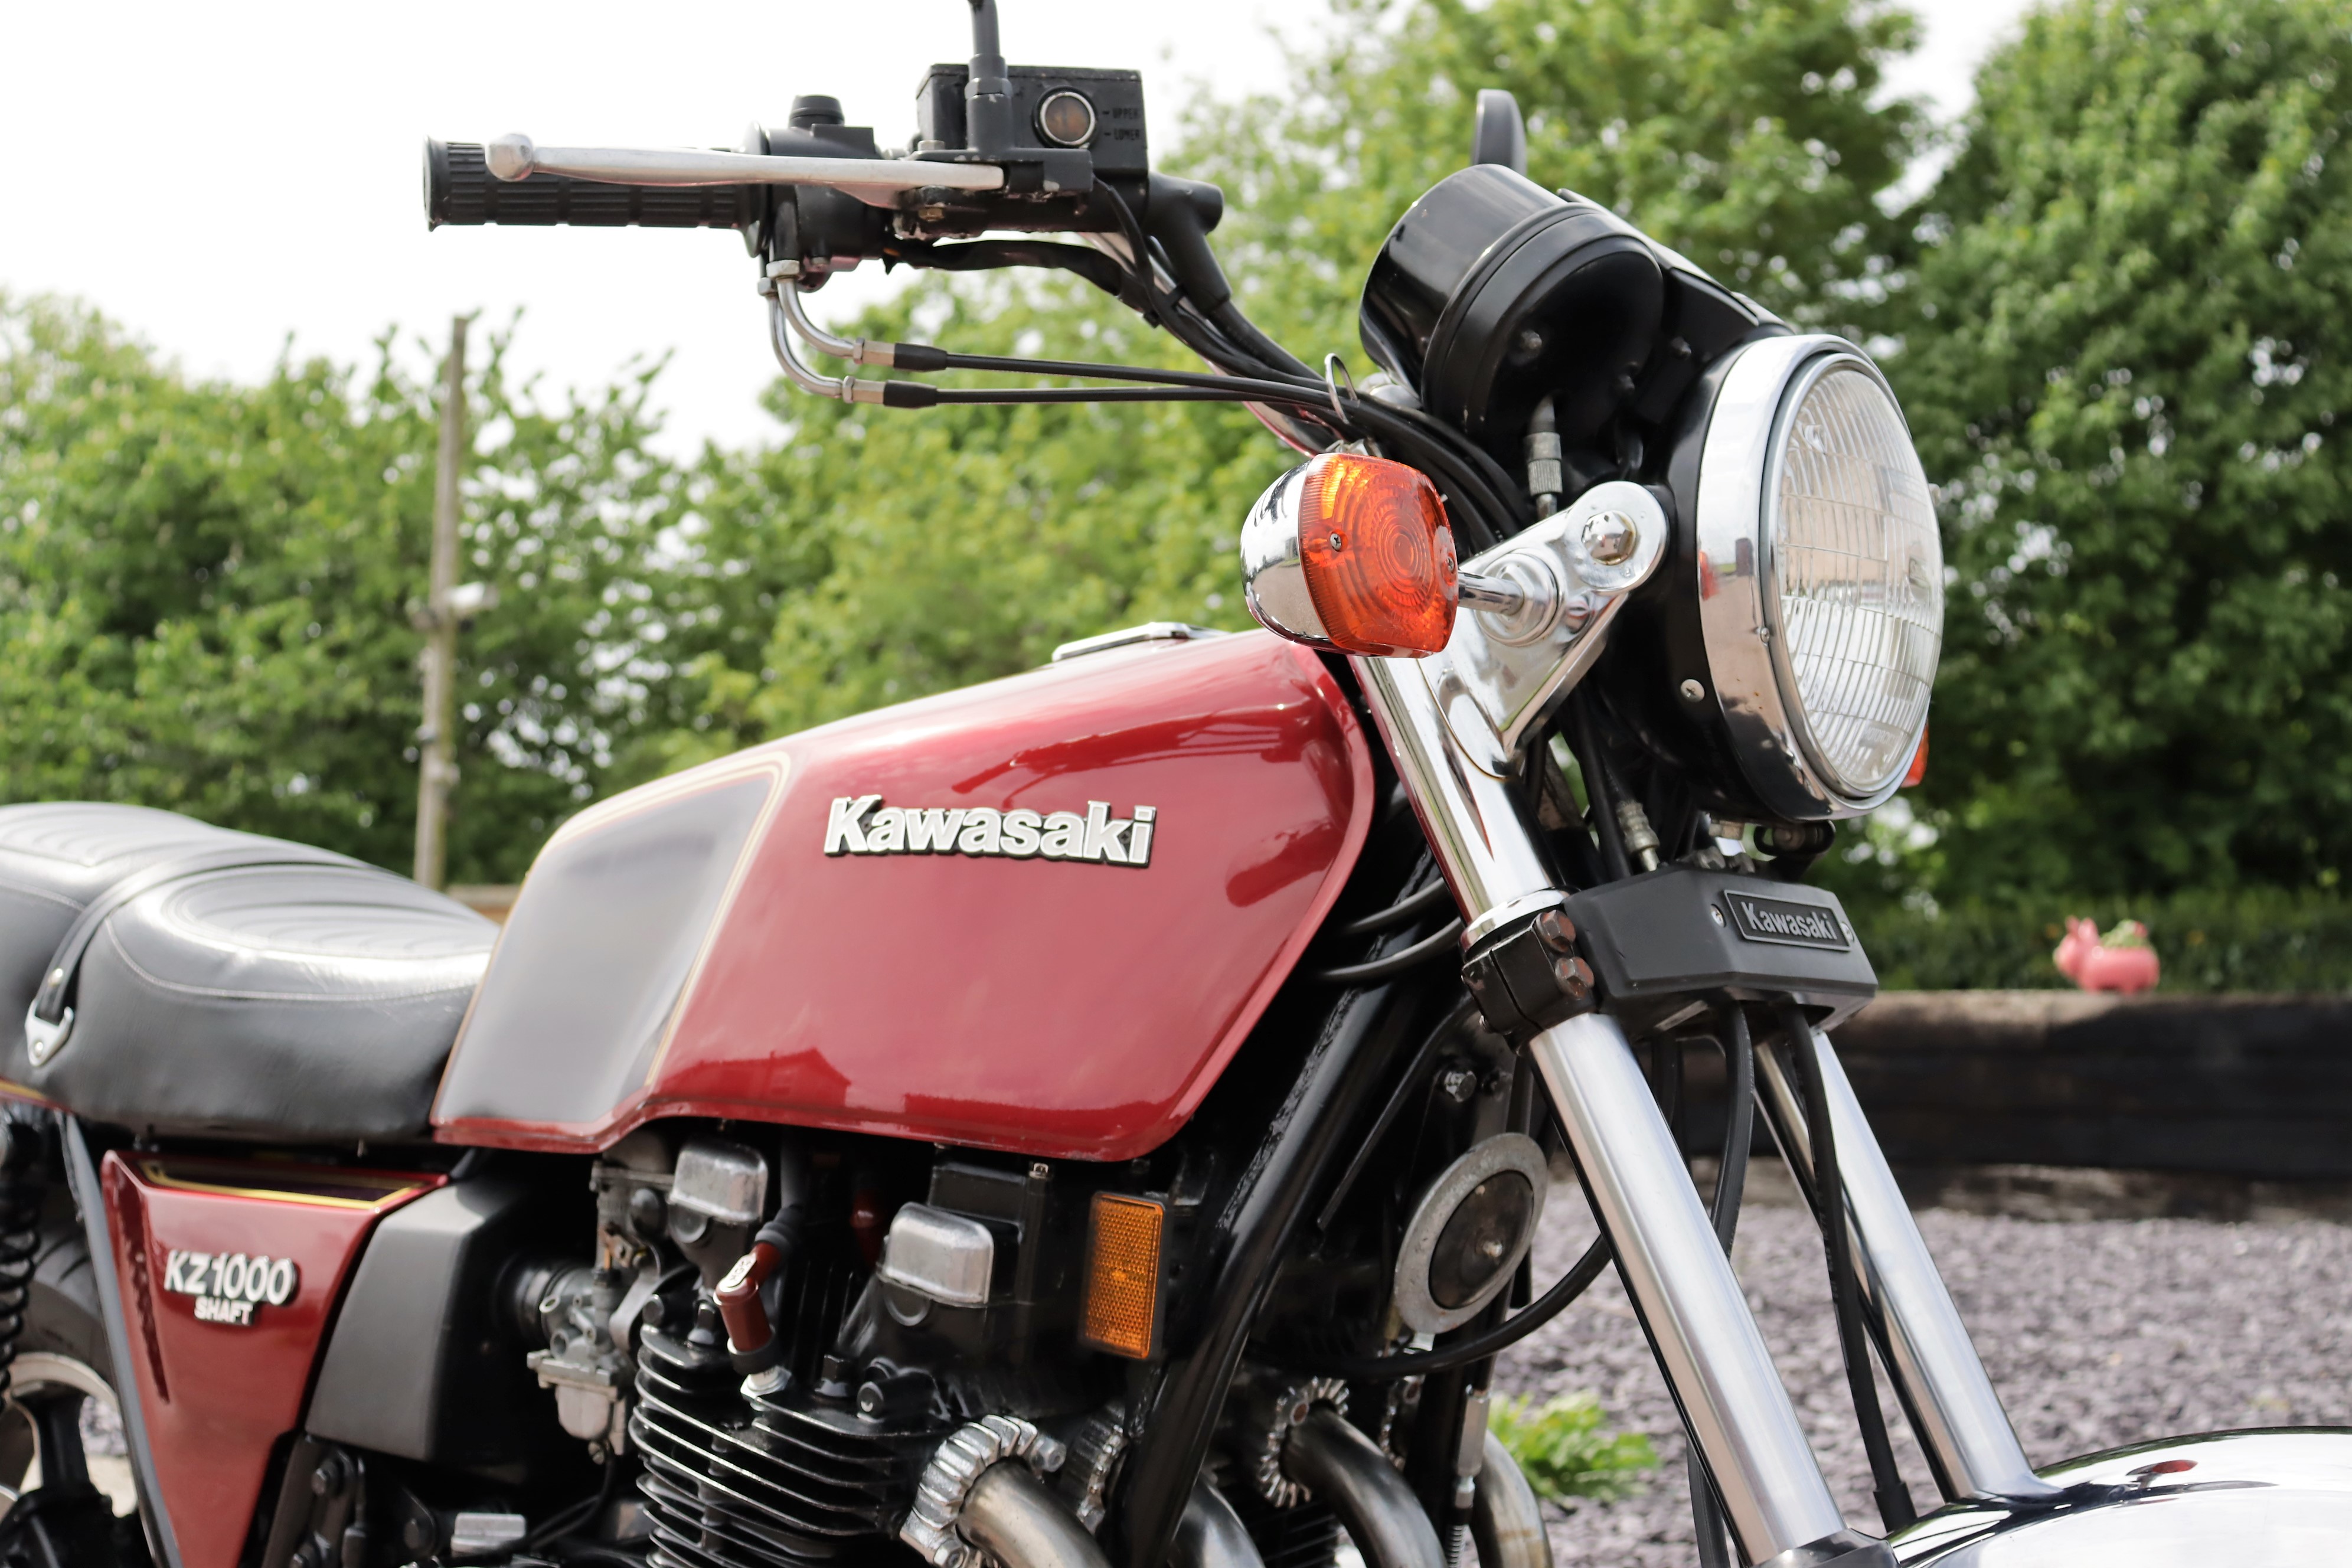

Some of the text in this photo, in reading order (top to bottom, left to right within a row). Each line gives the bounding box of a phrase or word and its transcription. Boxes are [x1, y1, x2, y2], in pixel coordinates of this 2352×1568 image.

[824, 794, 1156, 866] Kawasaki
[1741, 901, 1837, 940] Kawasaki
[164, 1249, 295, 1305] KZ1000
[194, 1296, 253, 1325] SHAFT
